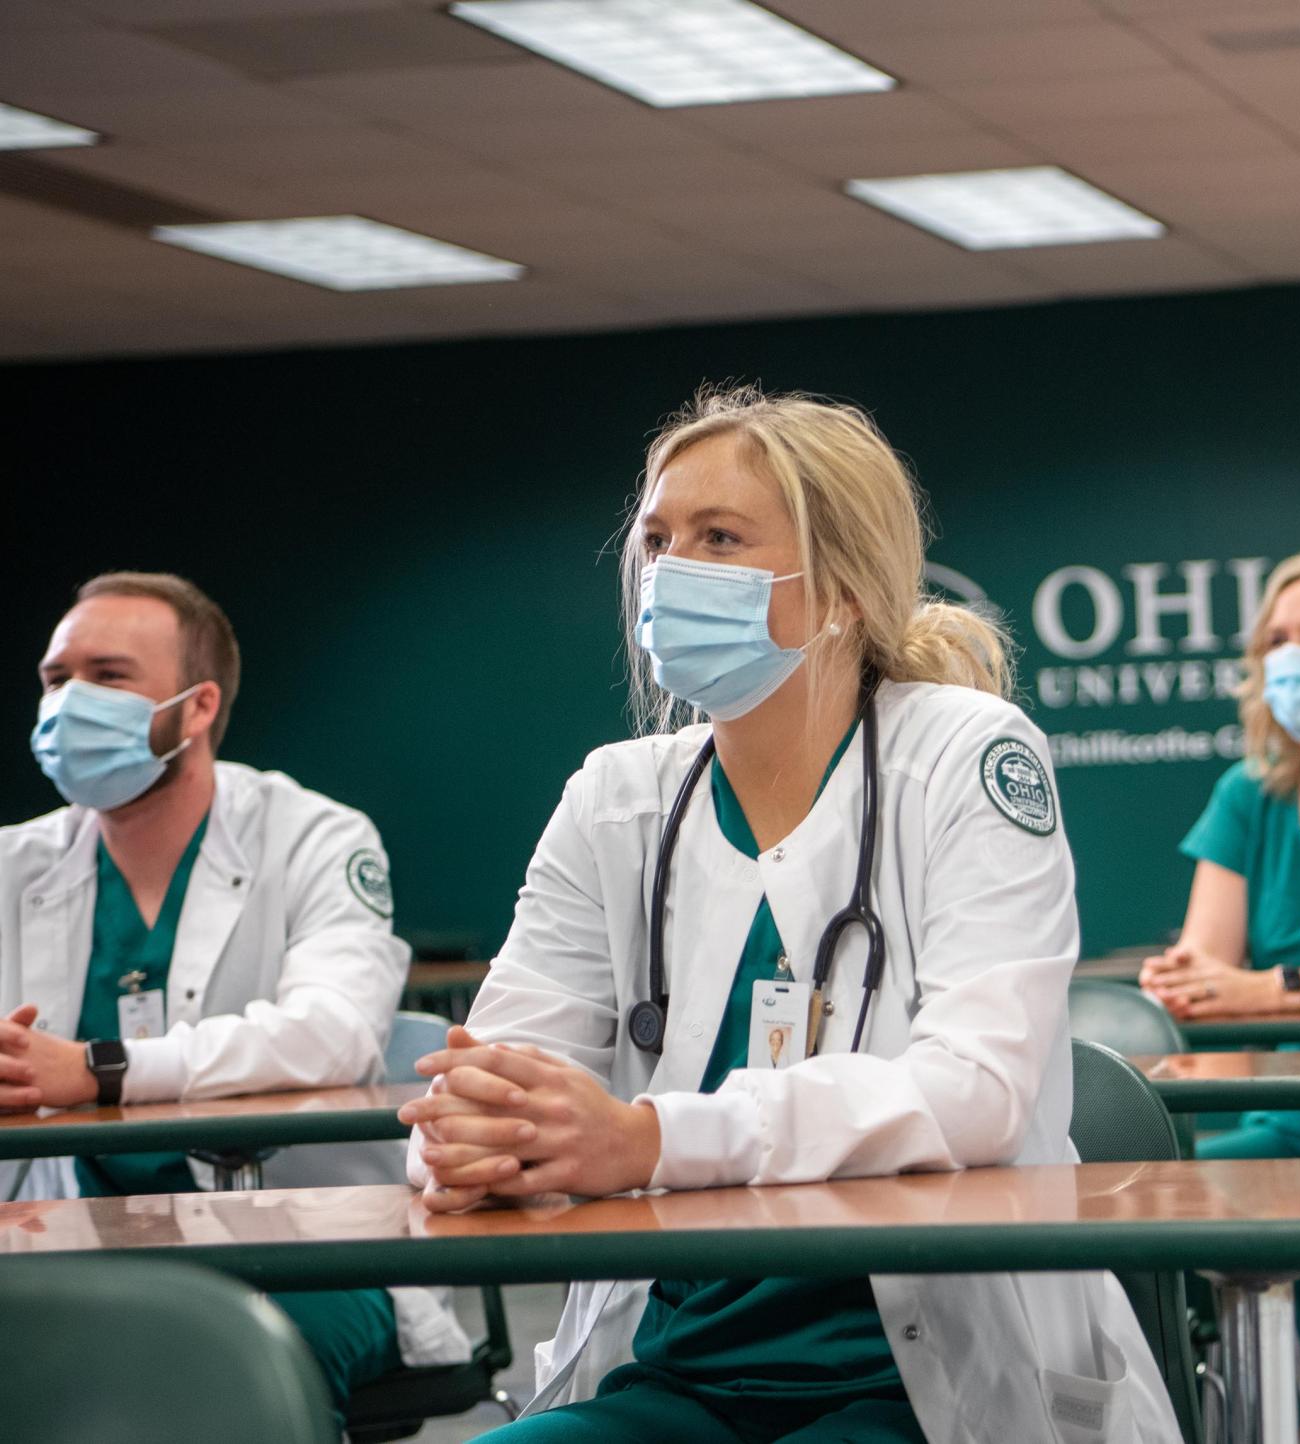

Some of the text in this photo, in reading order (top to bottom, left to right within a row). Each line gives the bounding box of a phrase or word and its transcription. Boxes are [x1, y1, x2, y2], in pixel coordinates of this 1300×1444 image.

[1033, 558, 1268, 659] OHI
[1037, 658, 1244, 706] UNIVER
[1006, 781, 1045, 804] OHIO
